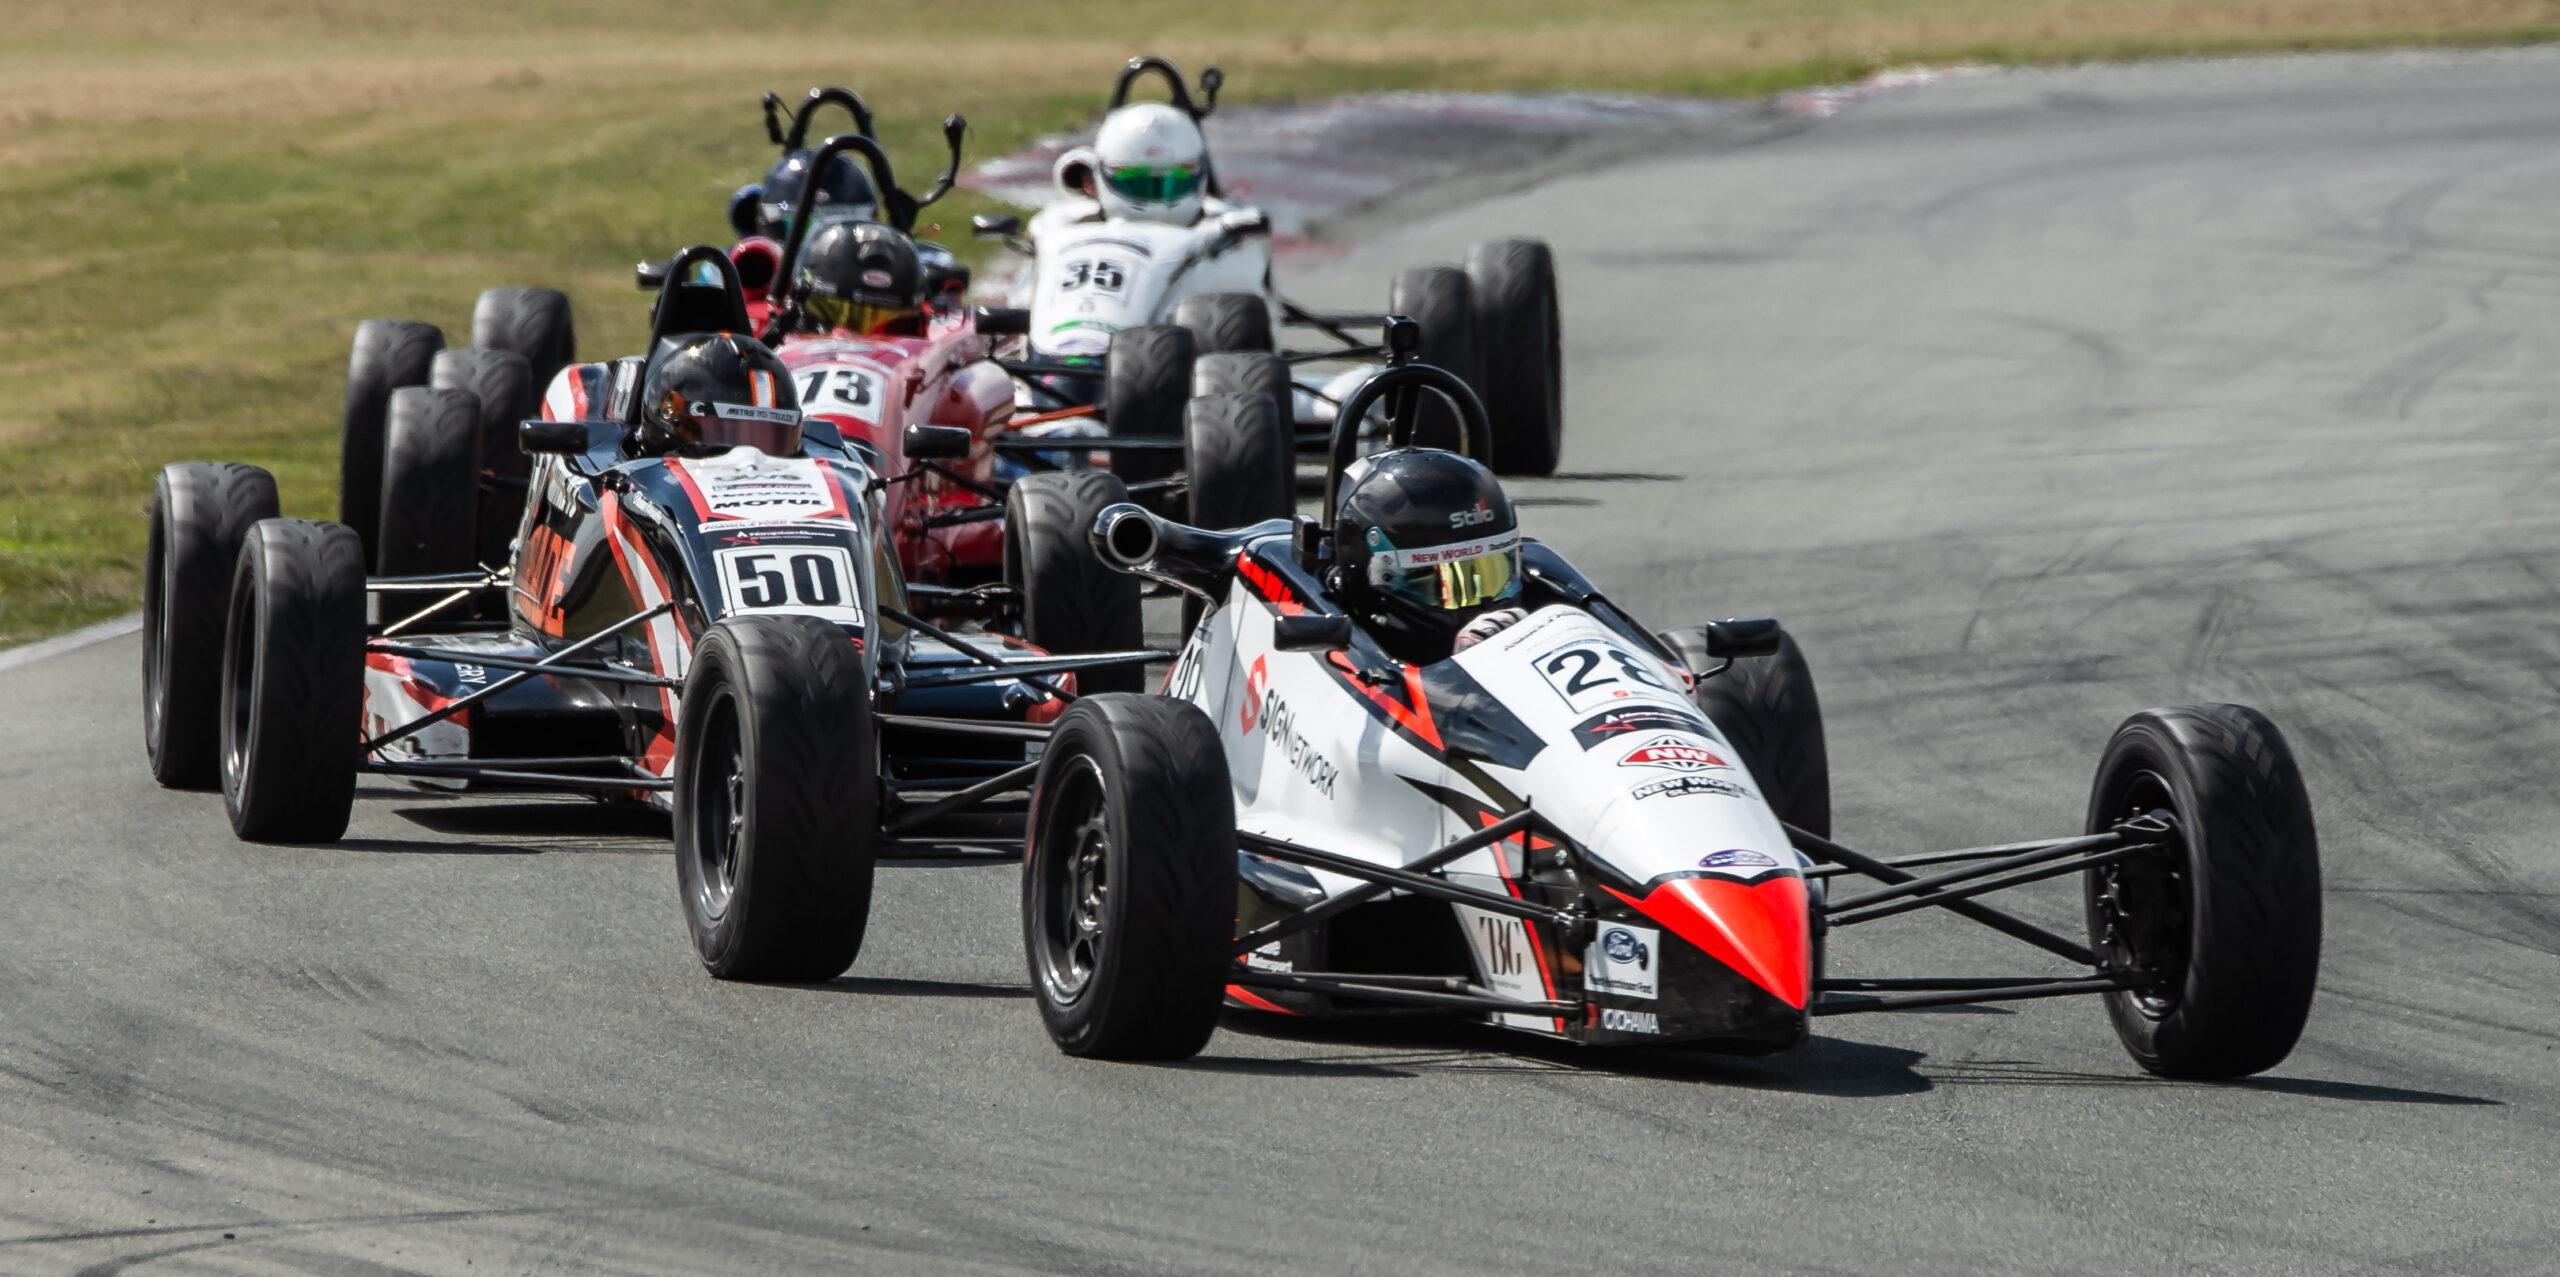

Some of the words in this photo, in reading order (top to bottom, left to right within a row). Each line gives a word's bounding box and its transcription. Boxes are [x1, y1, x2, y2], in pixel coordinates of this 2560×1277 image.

[1062, 261, 1123, 293] 35
[801, 369, 872, 406] 73
[713, 499, 827, 510] MOTUL
[1449, 503, 1495, 528] Stilo
[1412, 551, 1439, 564] NEW
[1441, 545, 1483, 560] WORLD
[735, 554, 841, 607] 50
[1548, 649, 1665, 697] 28
[1646, 748, 1709, 761] NW
[1633, 778, 1684, 800] NEW
[1608, 931, 1634, 957] Ford
